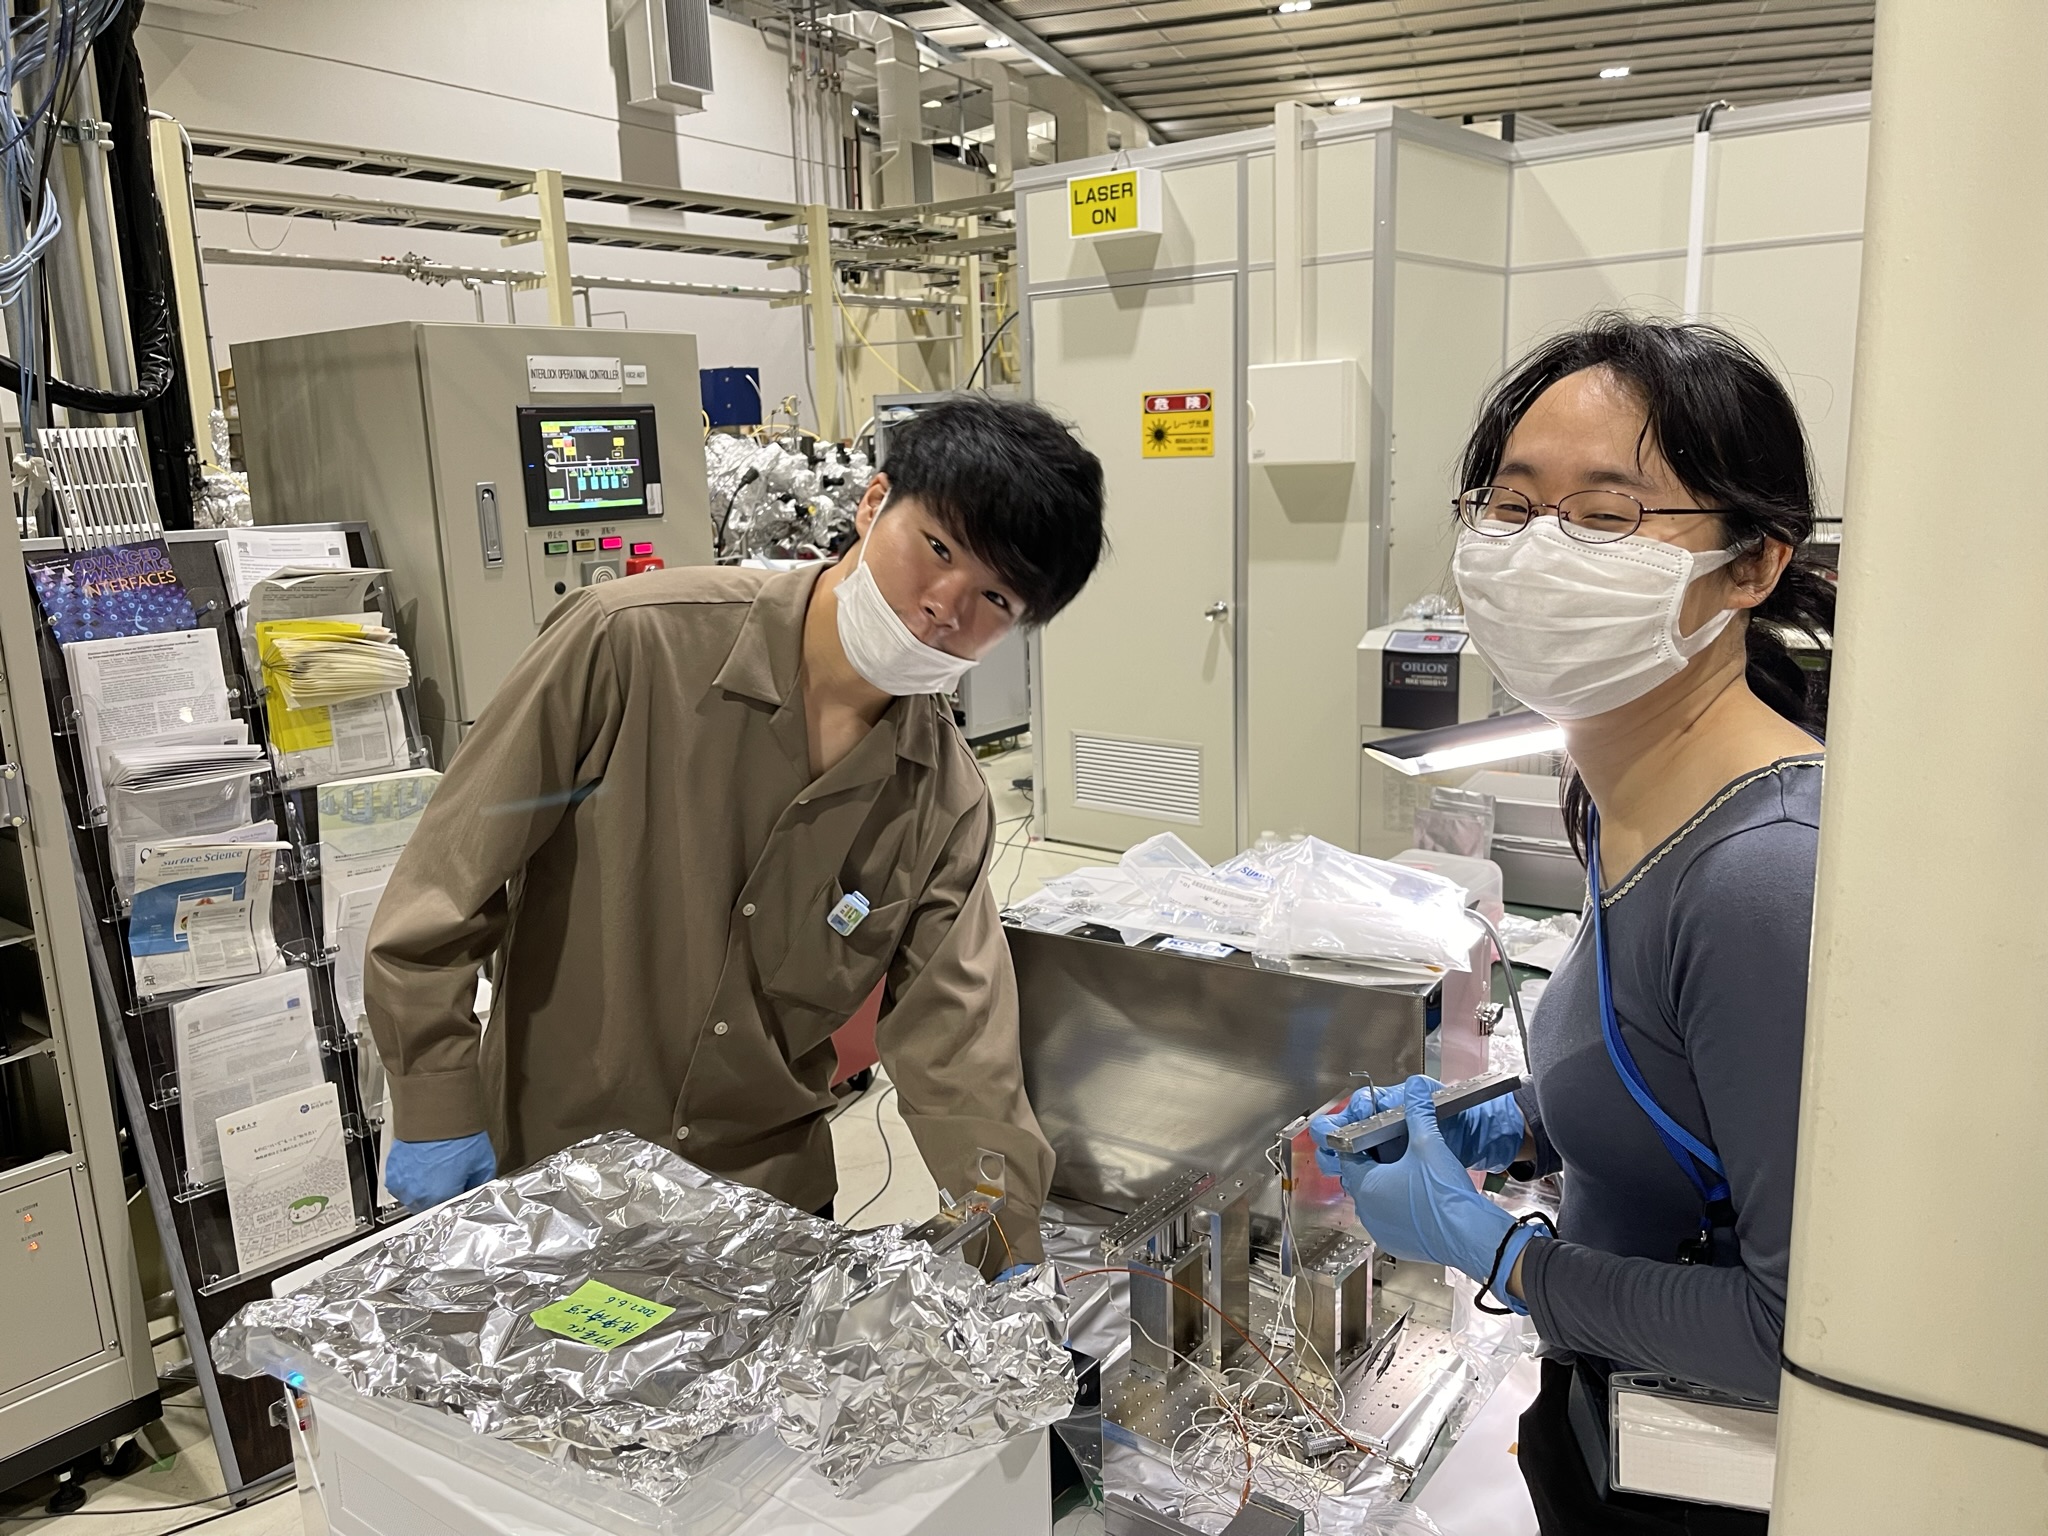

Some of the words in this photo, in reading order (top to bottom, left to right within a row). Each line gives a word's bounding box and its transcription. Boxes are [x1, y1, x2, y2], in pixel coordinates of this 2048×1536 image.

[1073, 182, 1134, 206] LASER
[1091, 206, 1117, 226] ON
[530, 368, 558, 379] INTERLOCK
[558, 369, 590, 380] OPERATIONAL
[590, 369, 619, 380] CONTROLLER
[1153, 396, 1202, 411] 危険
[72, 546, 162, 574] ADVANCED
[80, 557, 173, 586] MATERIALS
[85, 570, 177, 598] INTERFACES
[1401, 661, 1448, 674] ORION
[203, 850, 243, 864] Science
[1168, 939, 1227, 953] KOKEN
